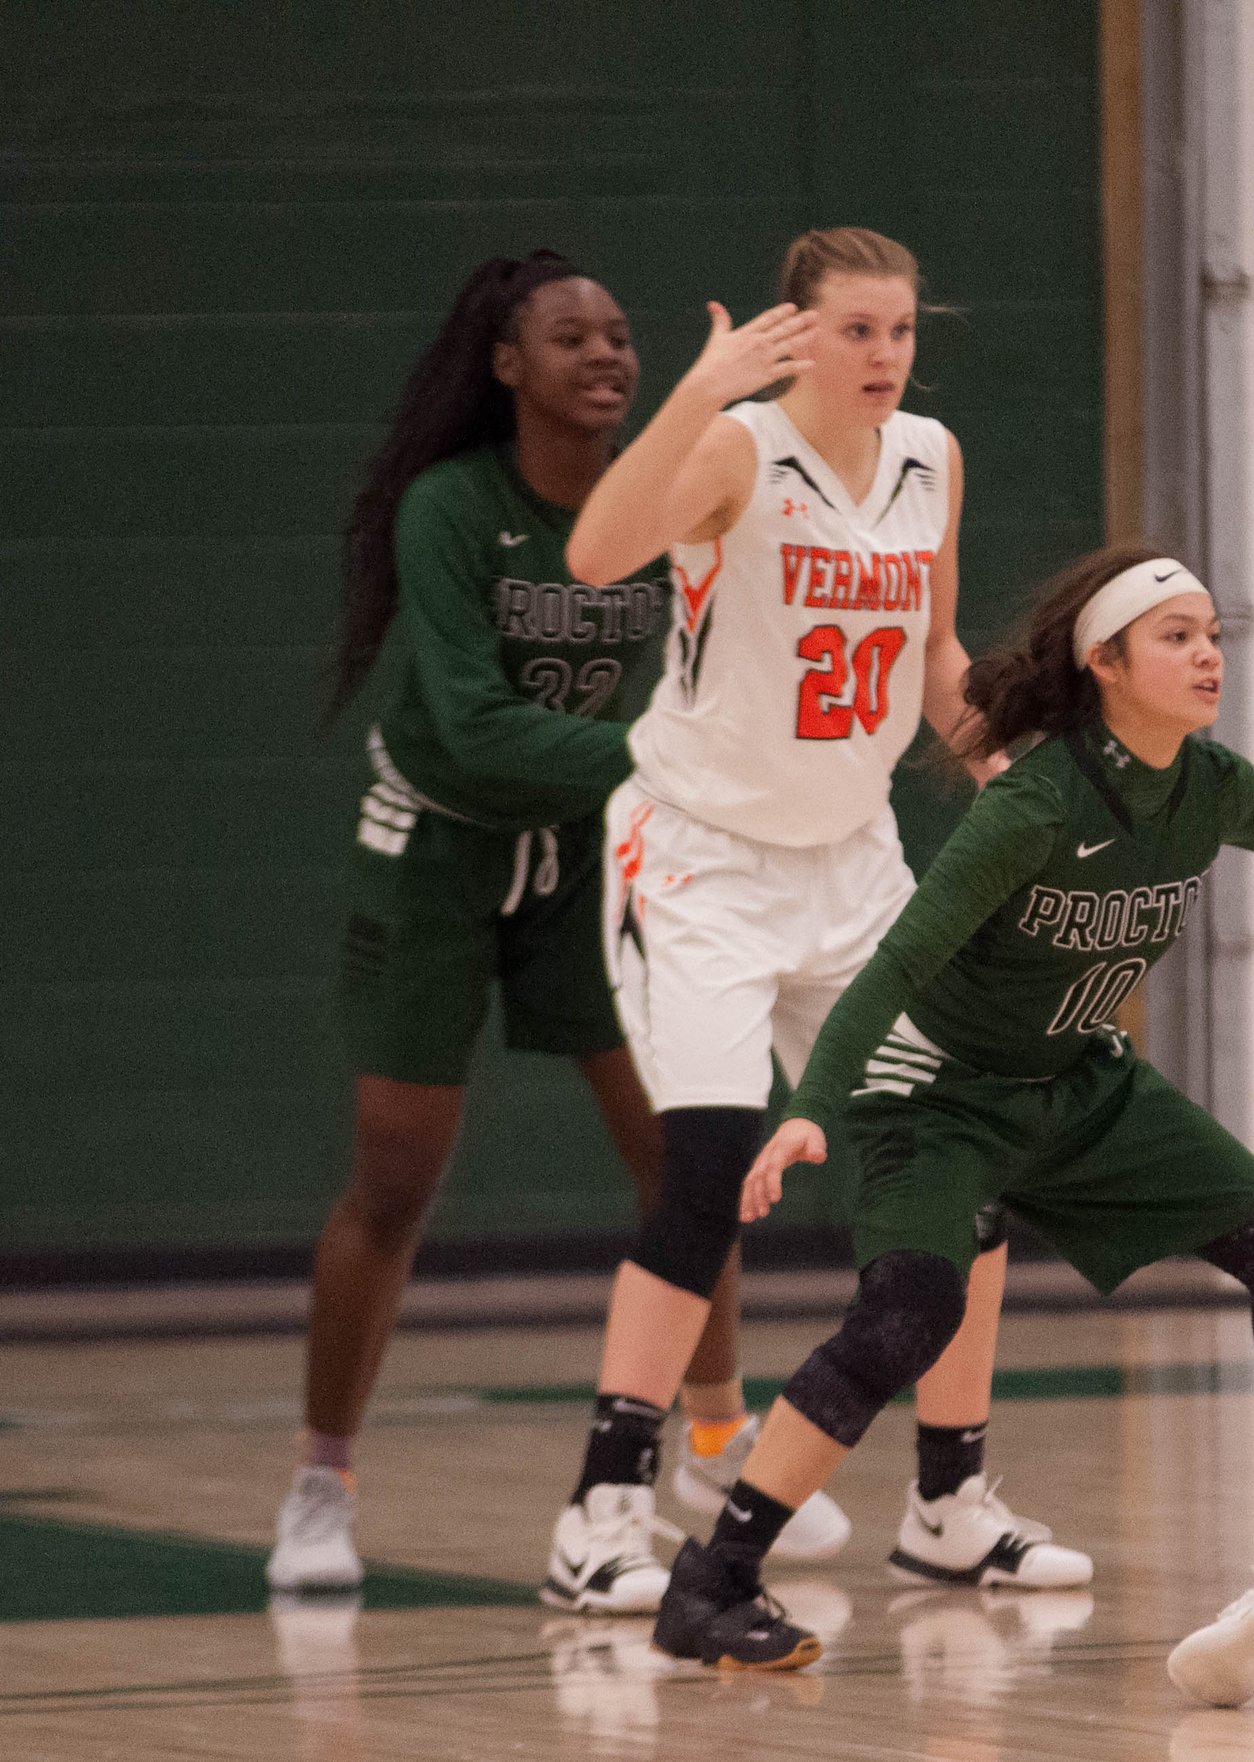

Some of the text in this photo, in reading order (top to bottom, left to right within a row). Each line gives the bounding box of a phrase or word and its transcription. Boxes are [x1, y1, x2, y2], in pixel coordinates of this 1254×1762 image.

[498, 577, 672, 644] ROCTO
[795, 623, 907, 740] 20
[1019, 869, 1209, 951] PROCTO
[1047, 957, 1147, 1035] 10
